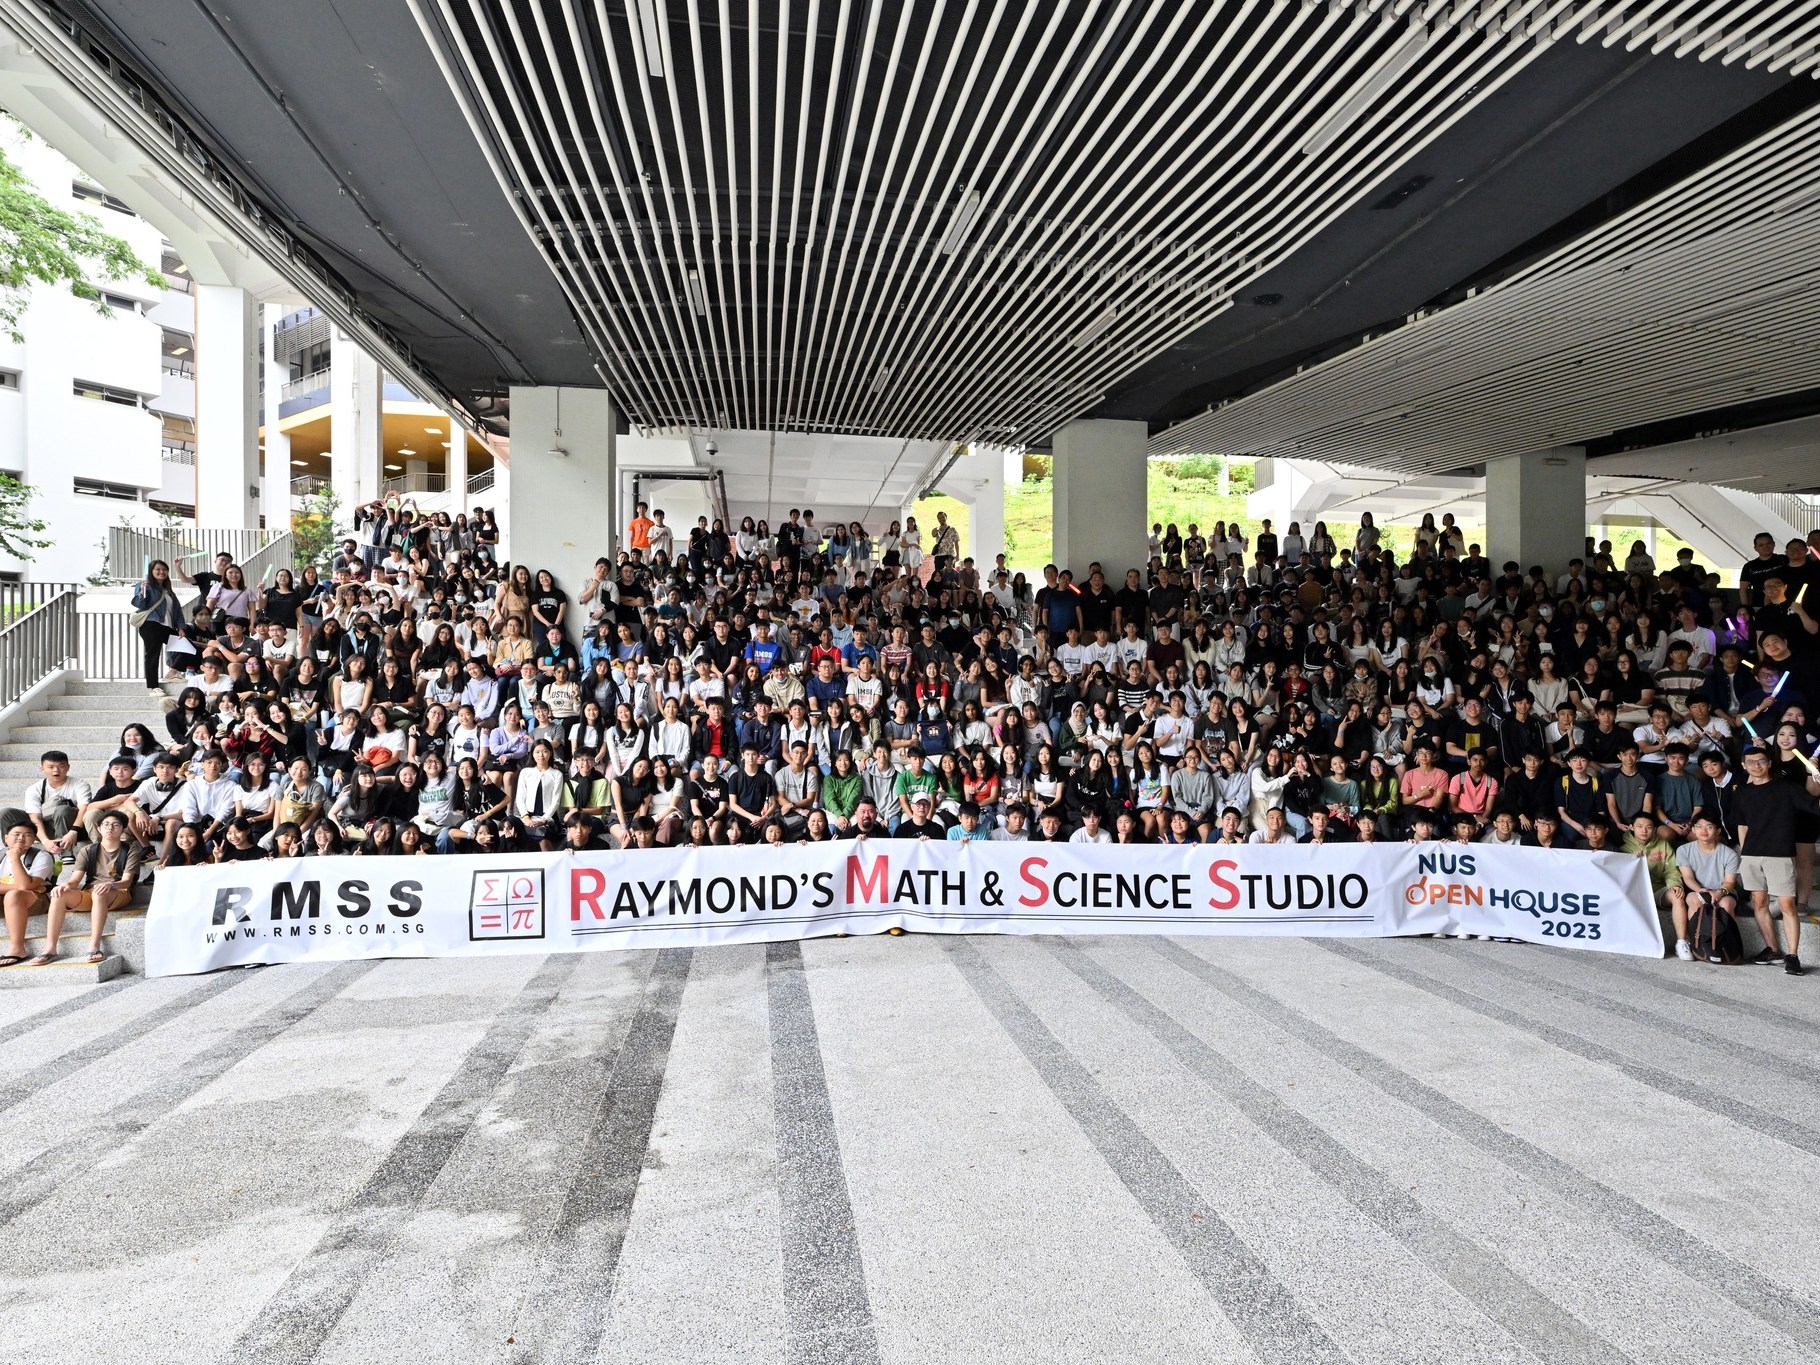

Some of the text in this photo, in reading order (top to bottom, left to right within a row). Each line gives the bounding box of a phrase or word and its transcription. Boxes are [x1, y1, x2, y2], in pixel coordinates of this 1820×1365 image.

[1418, 853, 1477, 876] NUS
[212, 879, 424, 926] RMSS
[980, 870, 1005, 906] &
[1405, 875, 1601, 918] OPEN HOUSE
[205, 923, 425, 944] WWW.RMSS.COM.SG
[1541, 920, 1602, 940] 2023
